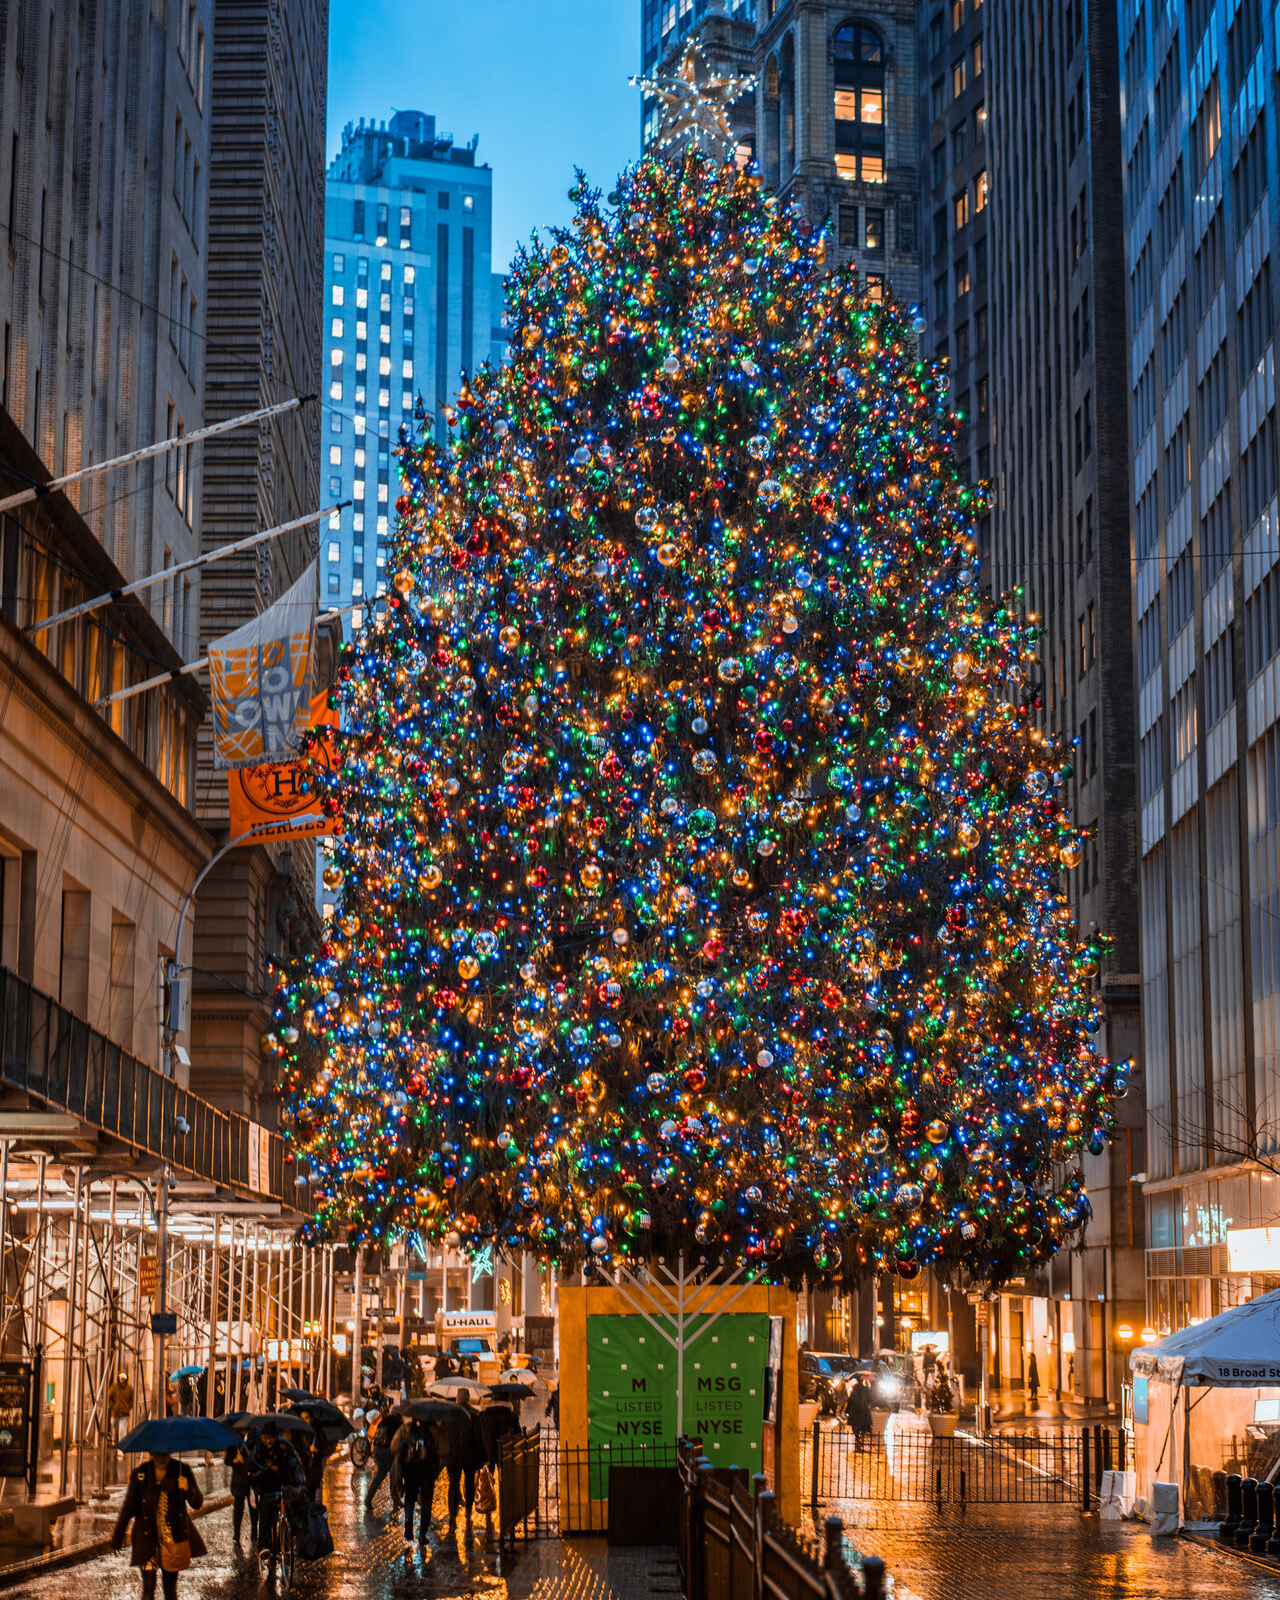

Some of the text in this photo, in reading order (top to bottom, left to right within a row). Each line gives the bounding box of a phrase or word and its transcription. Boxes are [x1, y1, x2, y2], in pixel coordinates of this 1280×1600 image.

[446, 1318, 492, 1327] U-HAUL
[1218, 1368, 1230, 1377] 18
[1232, 1368, 1266, 1378] Broad
[632, 1378, 646, 1392] M
[697, 1377, 742, 1391] MSG
[616, 1401, 663, 1412] LISTED
[696, 1400, 743, 1411] LISTED
[616, 1420, 663, 1435] NYSE
[697, 1420, 743, 1434] NYSE
